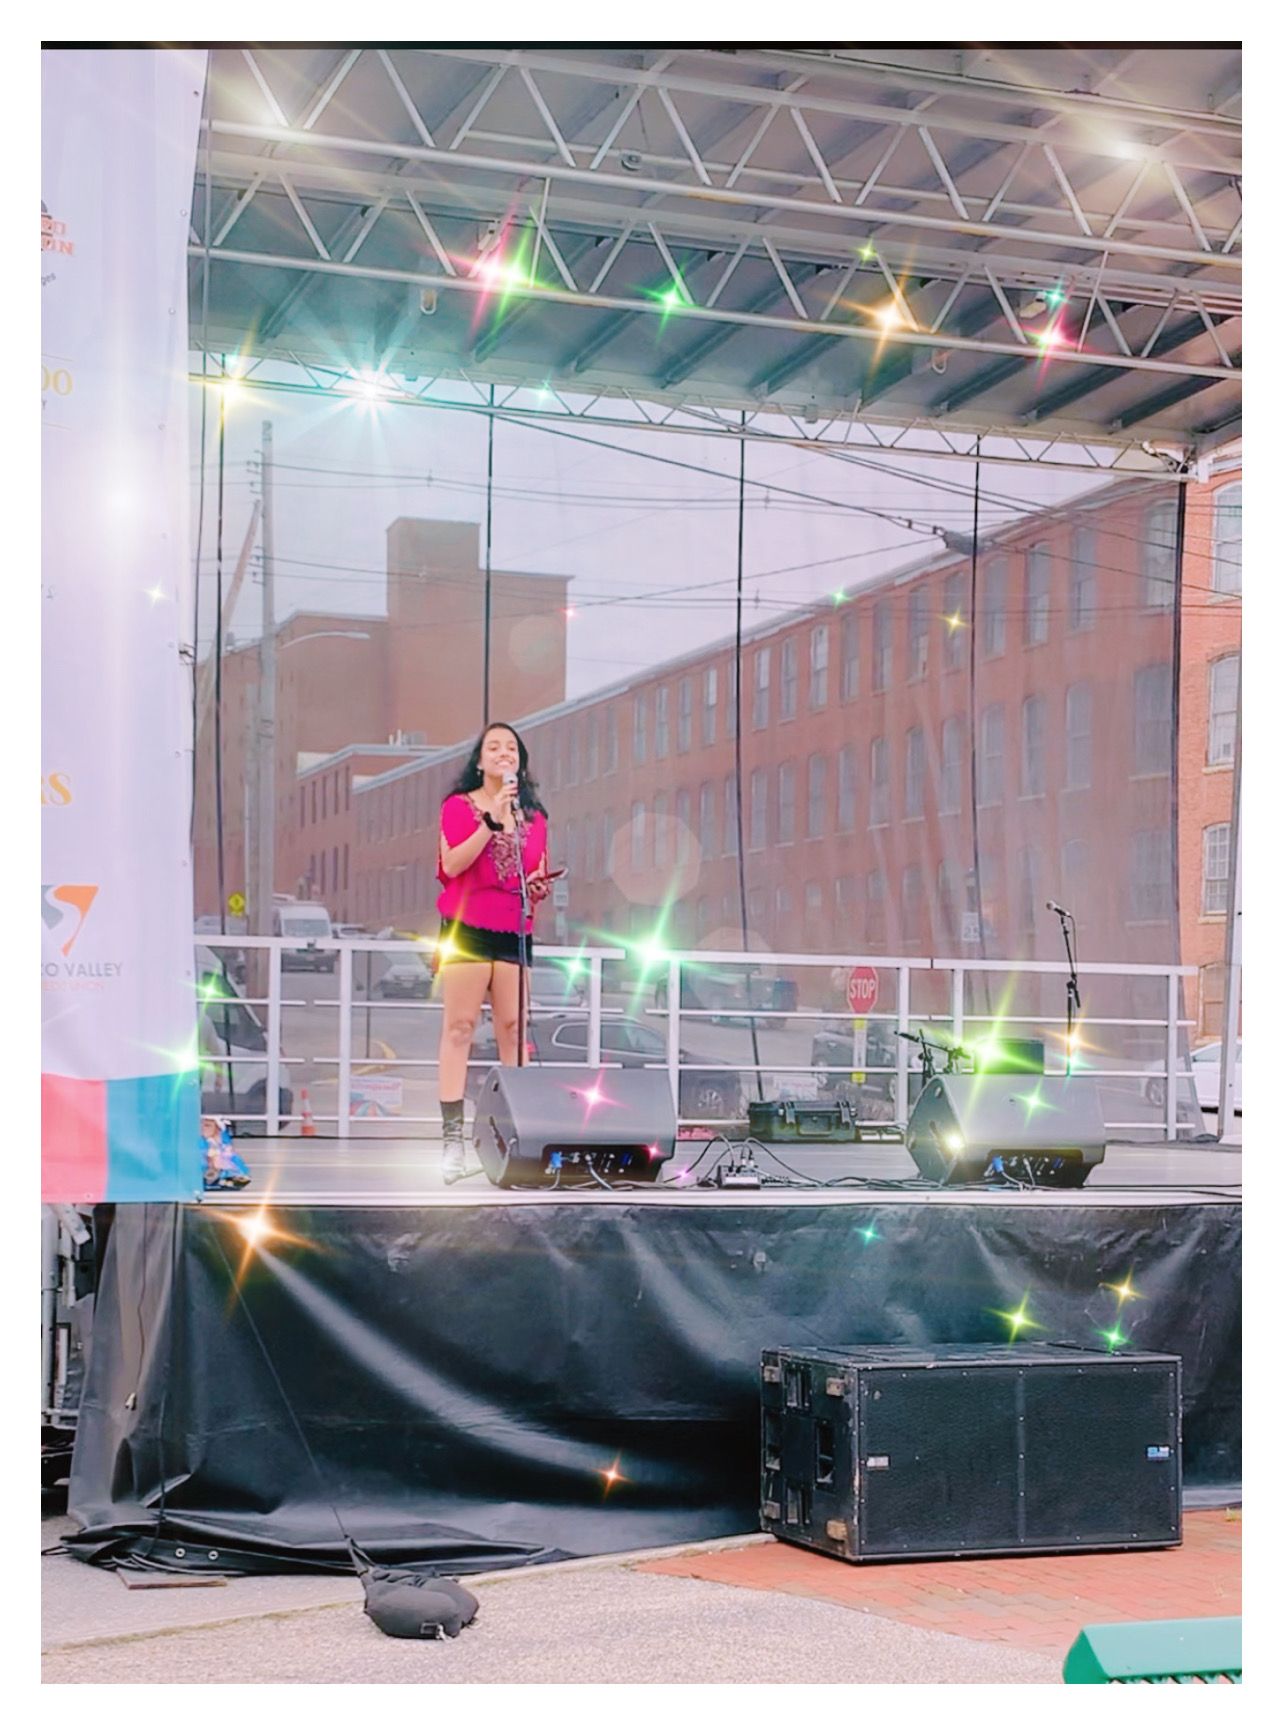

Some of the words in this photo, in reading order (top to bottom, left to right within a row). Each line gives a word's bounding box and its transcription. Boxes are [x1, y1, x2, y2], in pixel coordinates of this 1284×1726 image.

[41, 771, 72, 806] S
[41, 962, 59, 978] O
[64, 961, 123, 978] VALLEY
[849, 978, 876, 999] STOP
